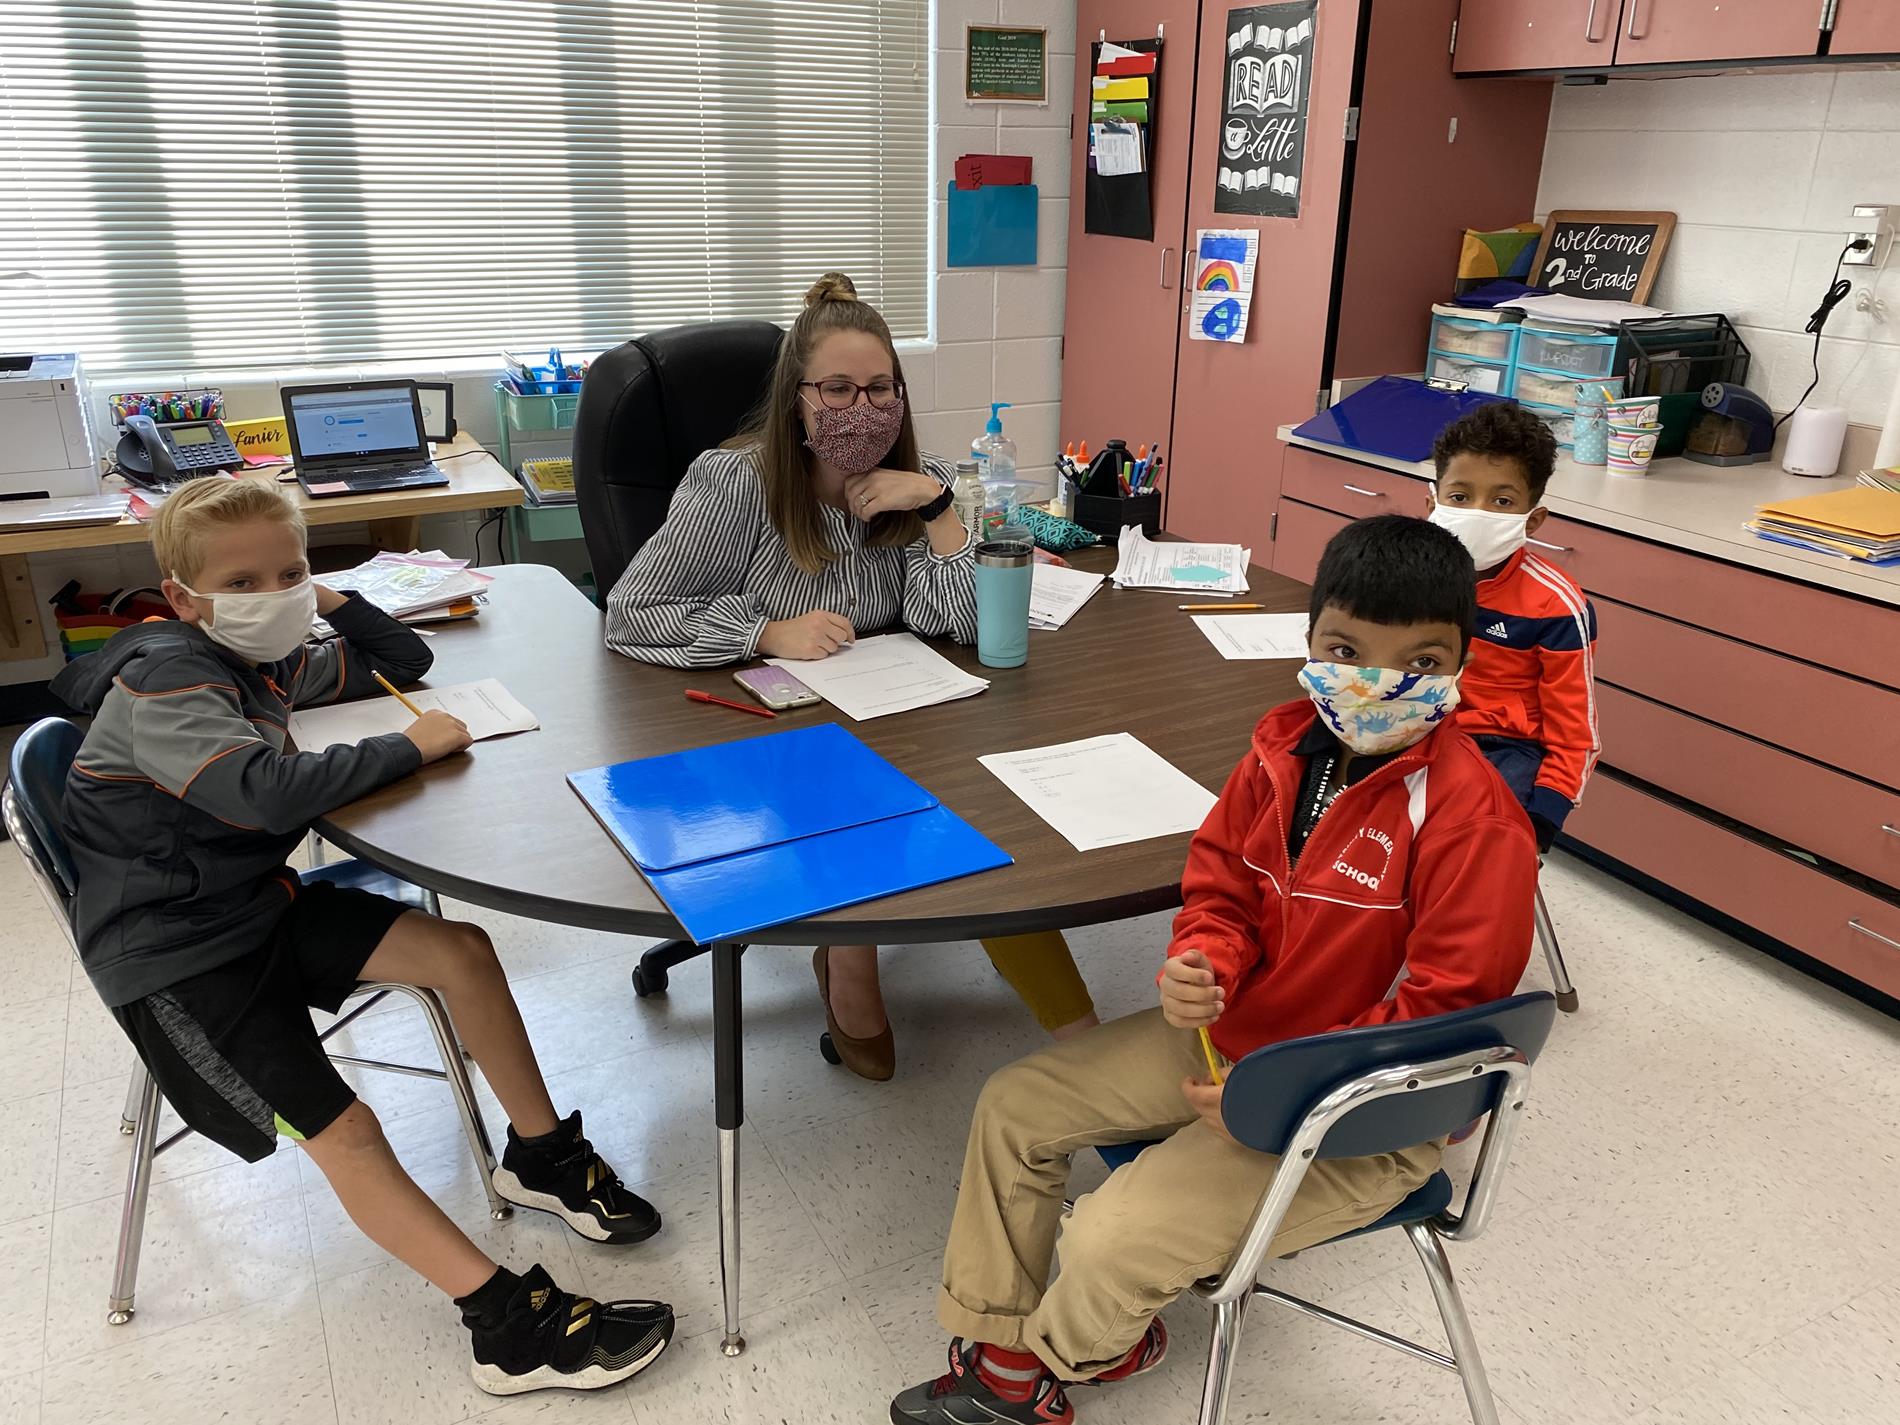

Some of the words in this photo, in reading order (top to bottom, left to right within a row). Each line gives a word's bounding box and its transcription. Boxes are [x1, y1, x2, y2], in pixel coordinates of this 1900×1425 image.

[1236, 60, 1294, 103] READ
[1247, 118, 1299, 162] Latte
[968, 163, 983, 188] xit
[1584, 254, 1597, 265] TO
[1582, 265, 1638, 291] Grade
